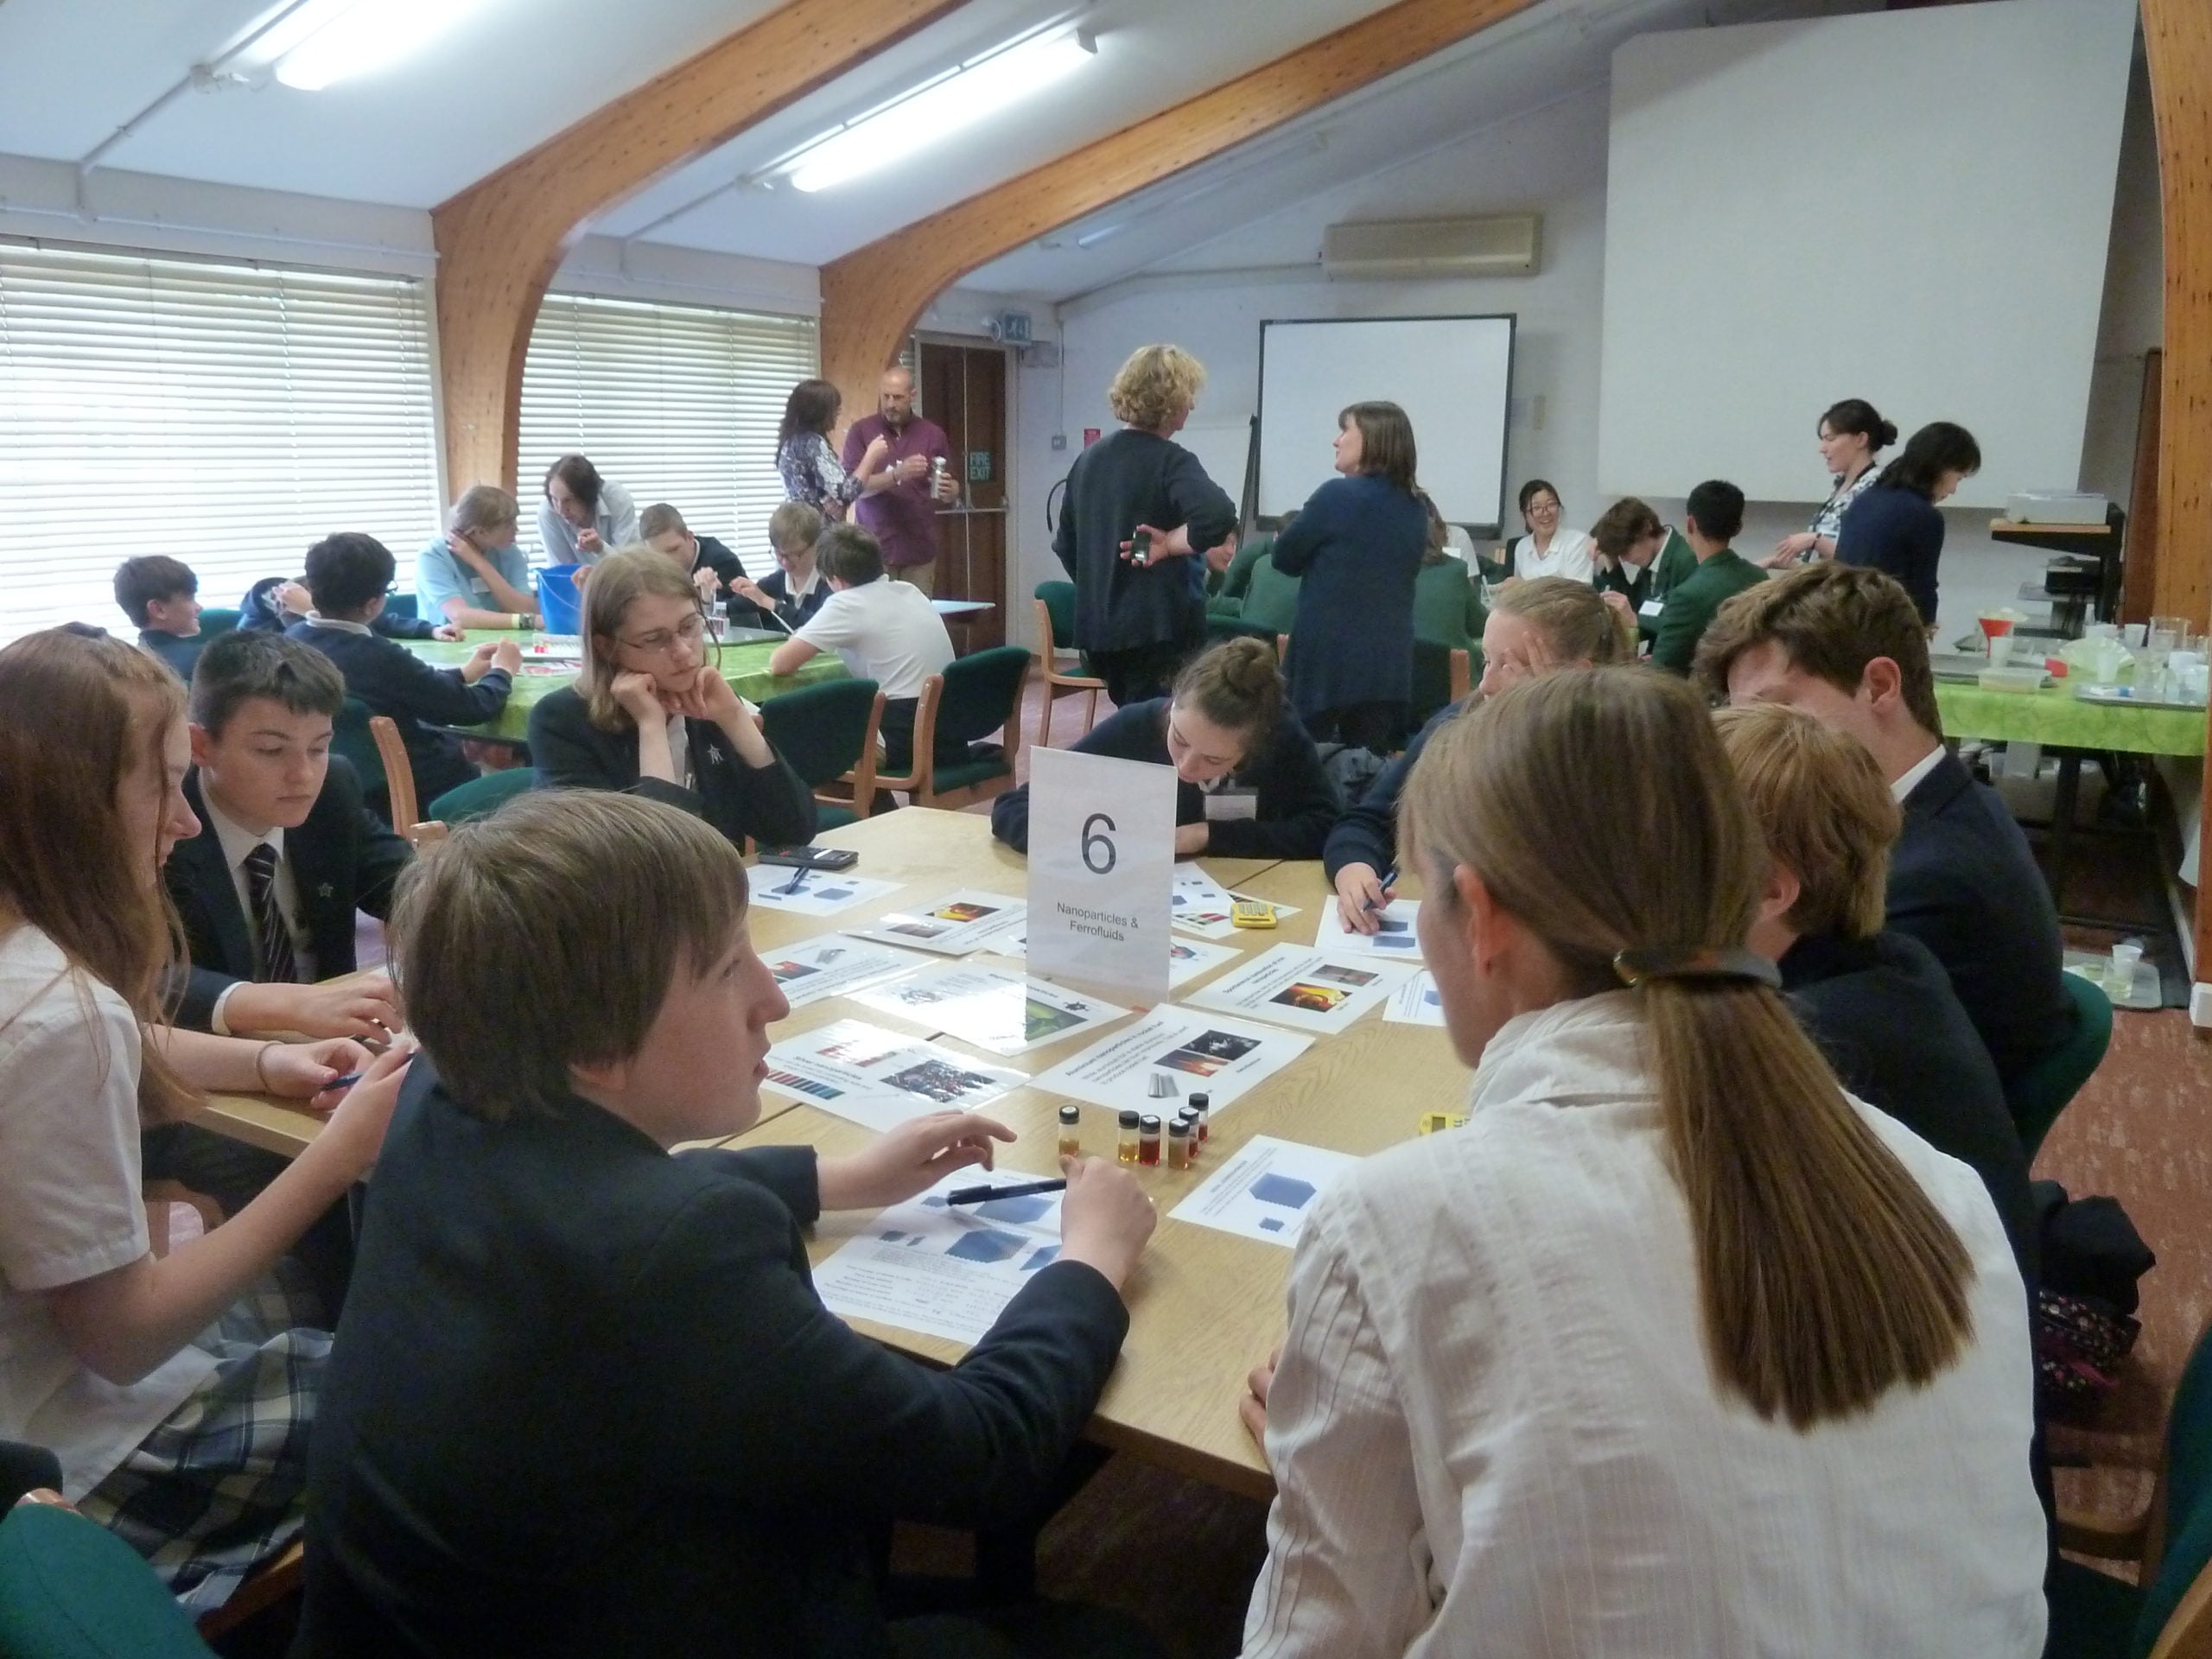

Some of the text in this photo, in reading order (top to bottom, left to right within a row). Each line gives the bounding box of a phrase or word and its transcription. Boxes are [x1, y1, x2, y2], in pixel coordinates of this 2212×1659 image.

[969, 452, 990, 466] FIRE
[969, 467, 990, 480] EXIT
[1082, 813, 1116, 874] 6
[1057, 902, 1139, 929] Nanoparticles &
[1070, 920, 1124, 942] Ferrofluids
